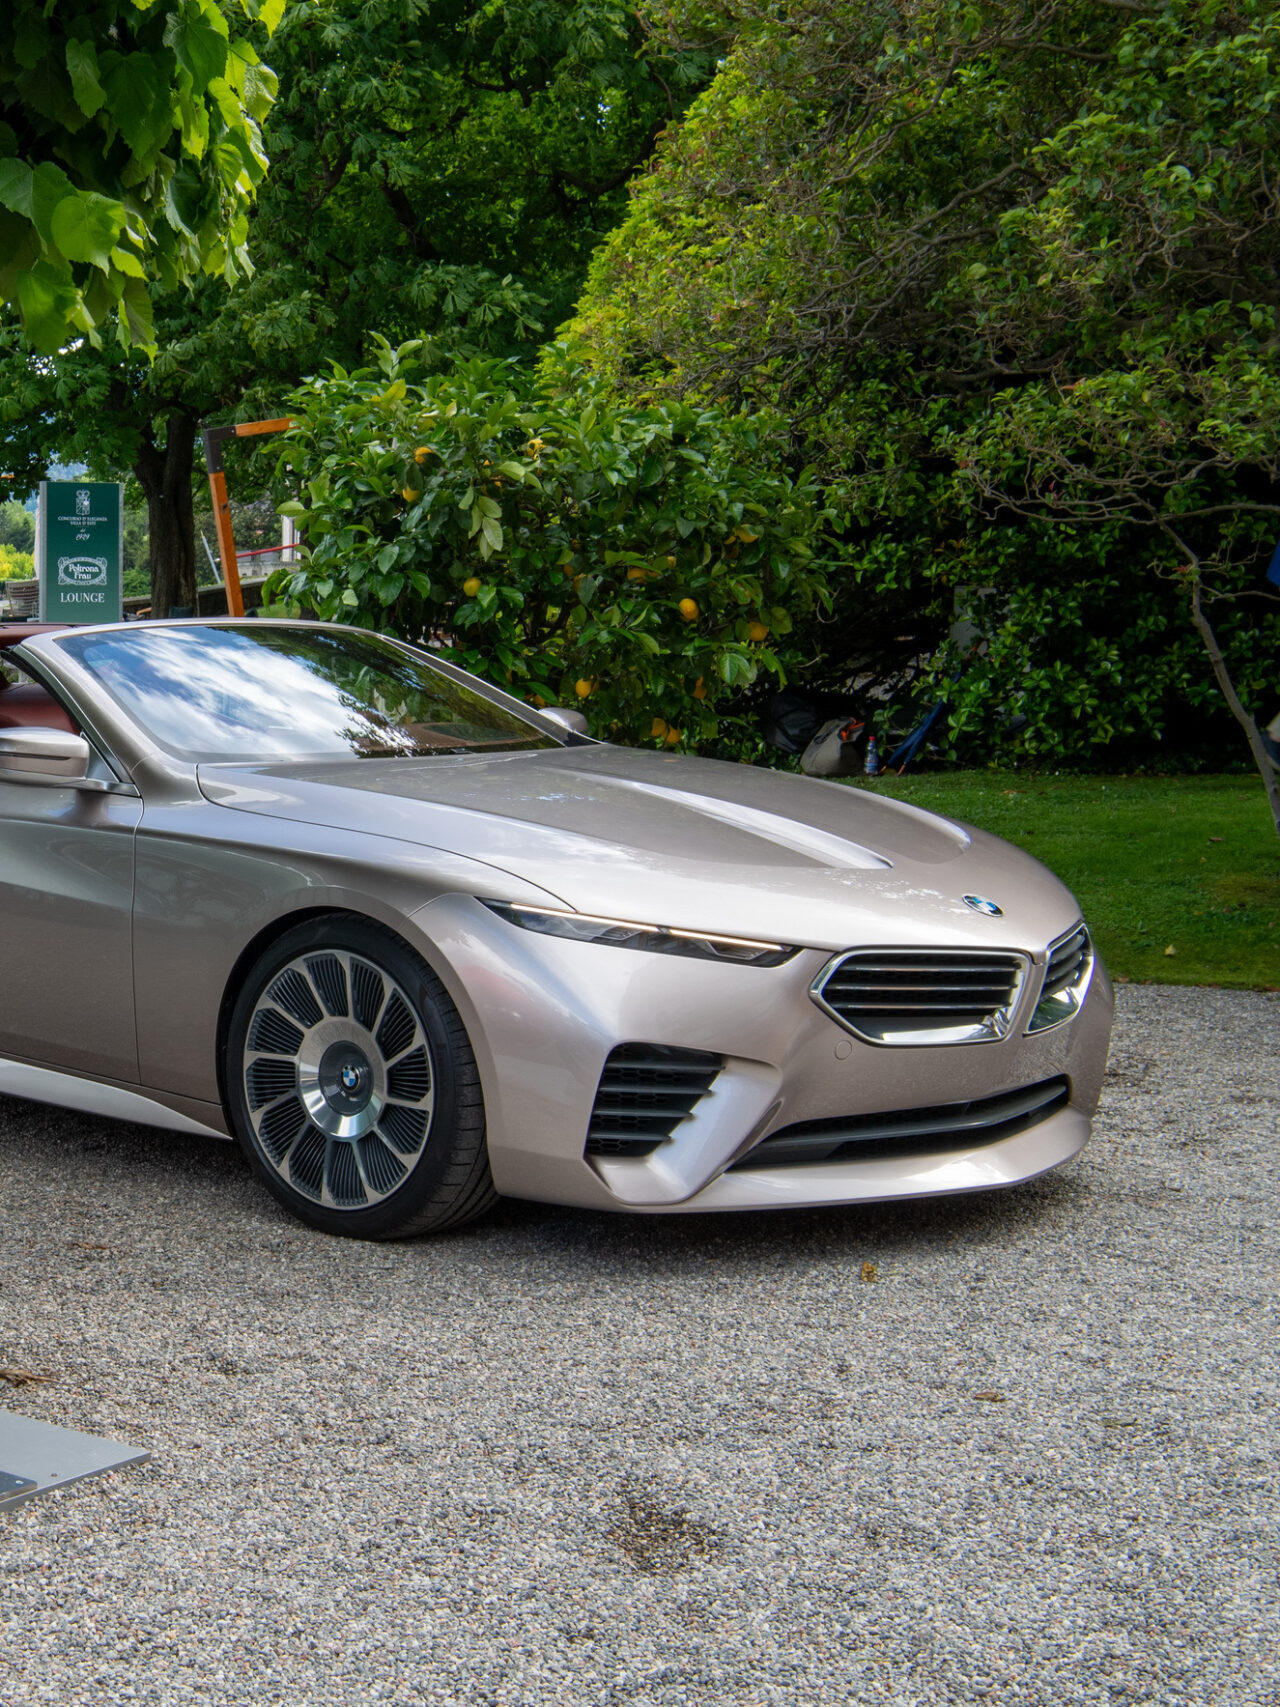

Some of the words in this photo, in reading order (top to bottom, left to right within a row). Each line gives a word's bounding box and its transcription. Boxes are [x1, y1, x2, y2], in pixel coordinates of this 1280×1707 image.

[69, 563, 99, 573] Poltrona
[74, 572, 92, 580] Frau
[60, 592, 105, 603] LOUNGE
